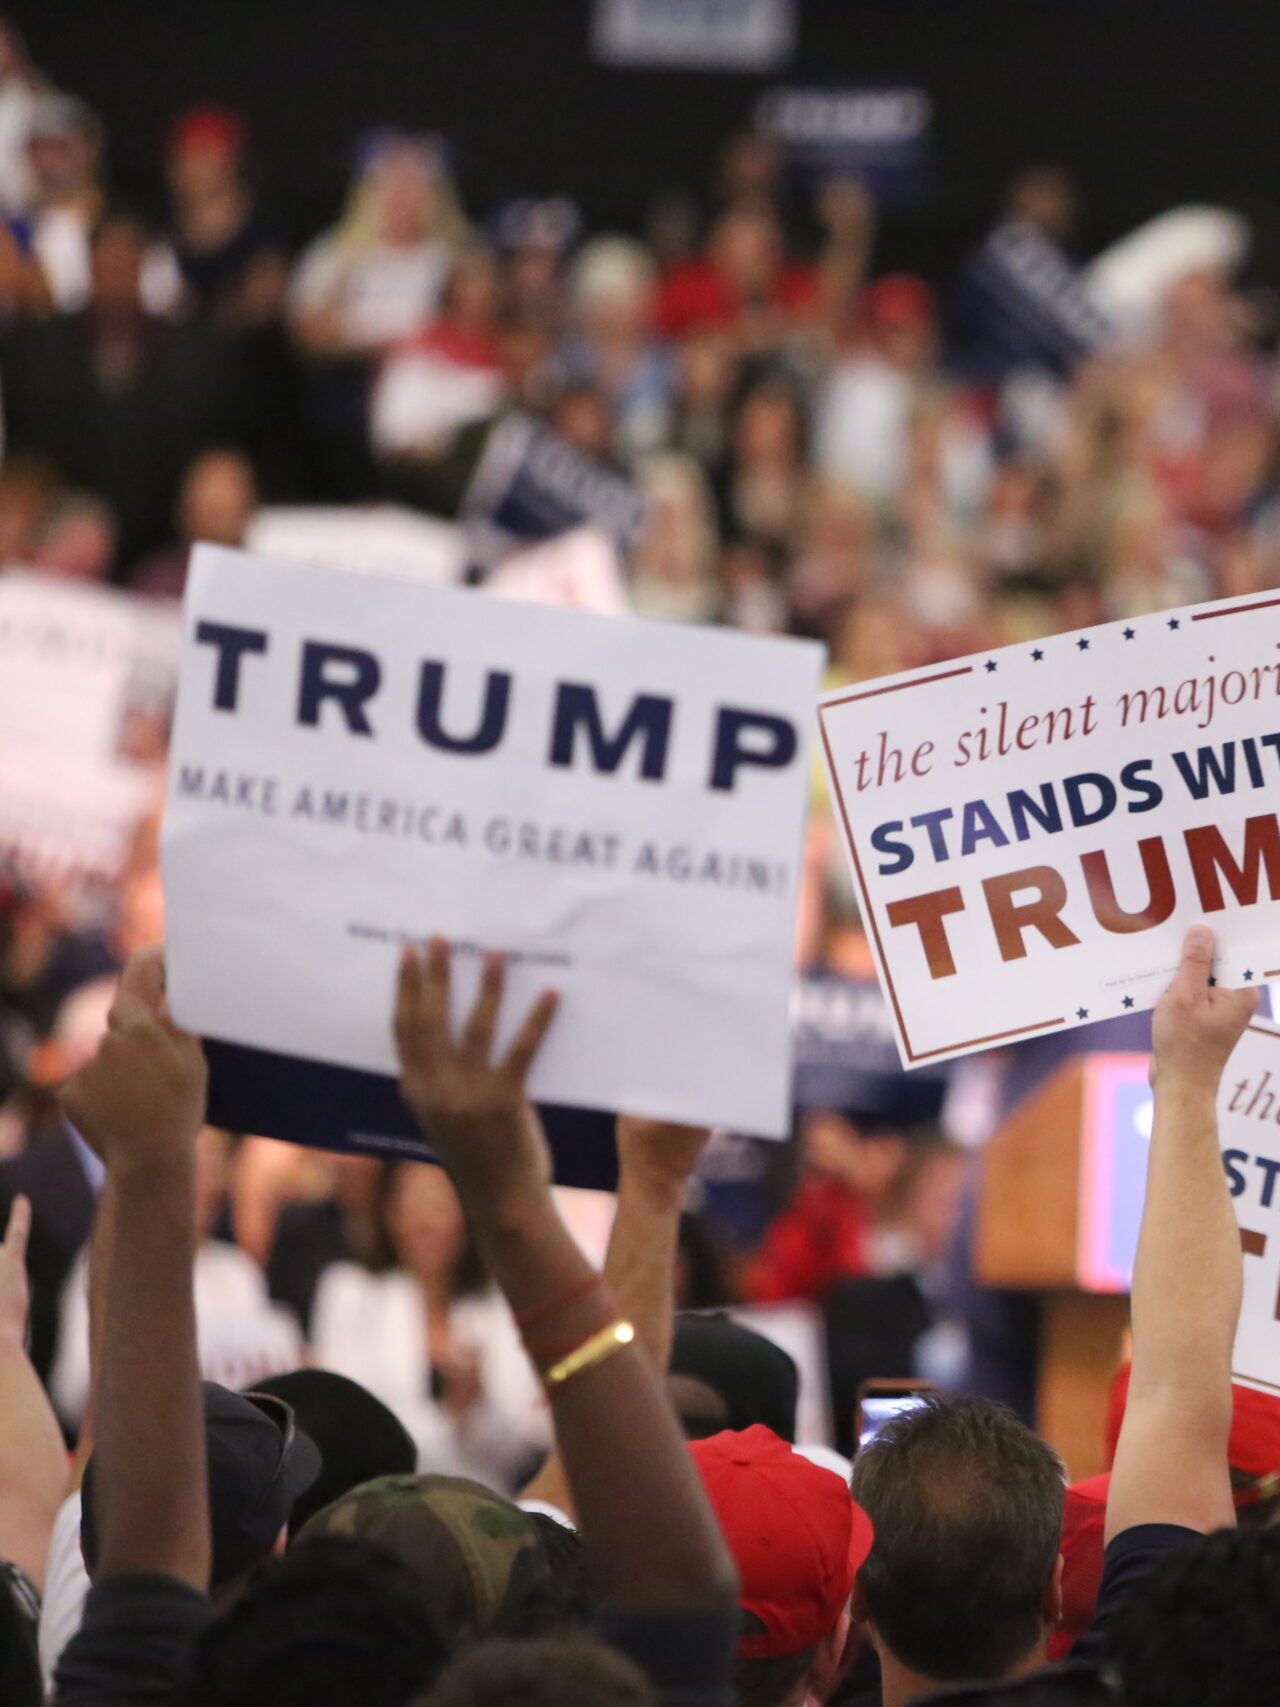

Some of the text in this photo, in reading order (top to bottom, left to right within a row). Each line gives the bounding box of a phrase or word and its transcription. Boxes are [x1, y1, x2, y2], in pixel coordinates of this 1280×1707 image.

[194, 619, 800, 795] TRUMP
[853, 731, 935, 791] the
[953, 695, 1099, 768] silent
[175, 765, 791, 895] MAKE AMERICA GREAT AGAIN!
[870, 758, 1164, 876] STANDS
